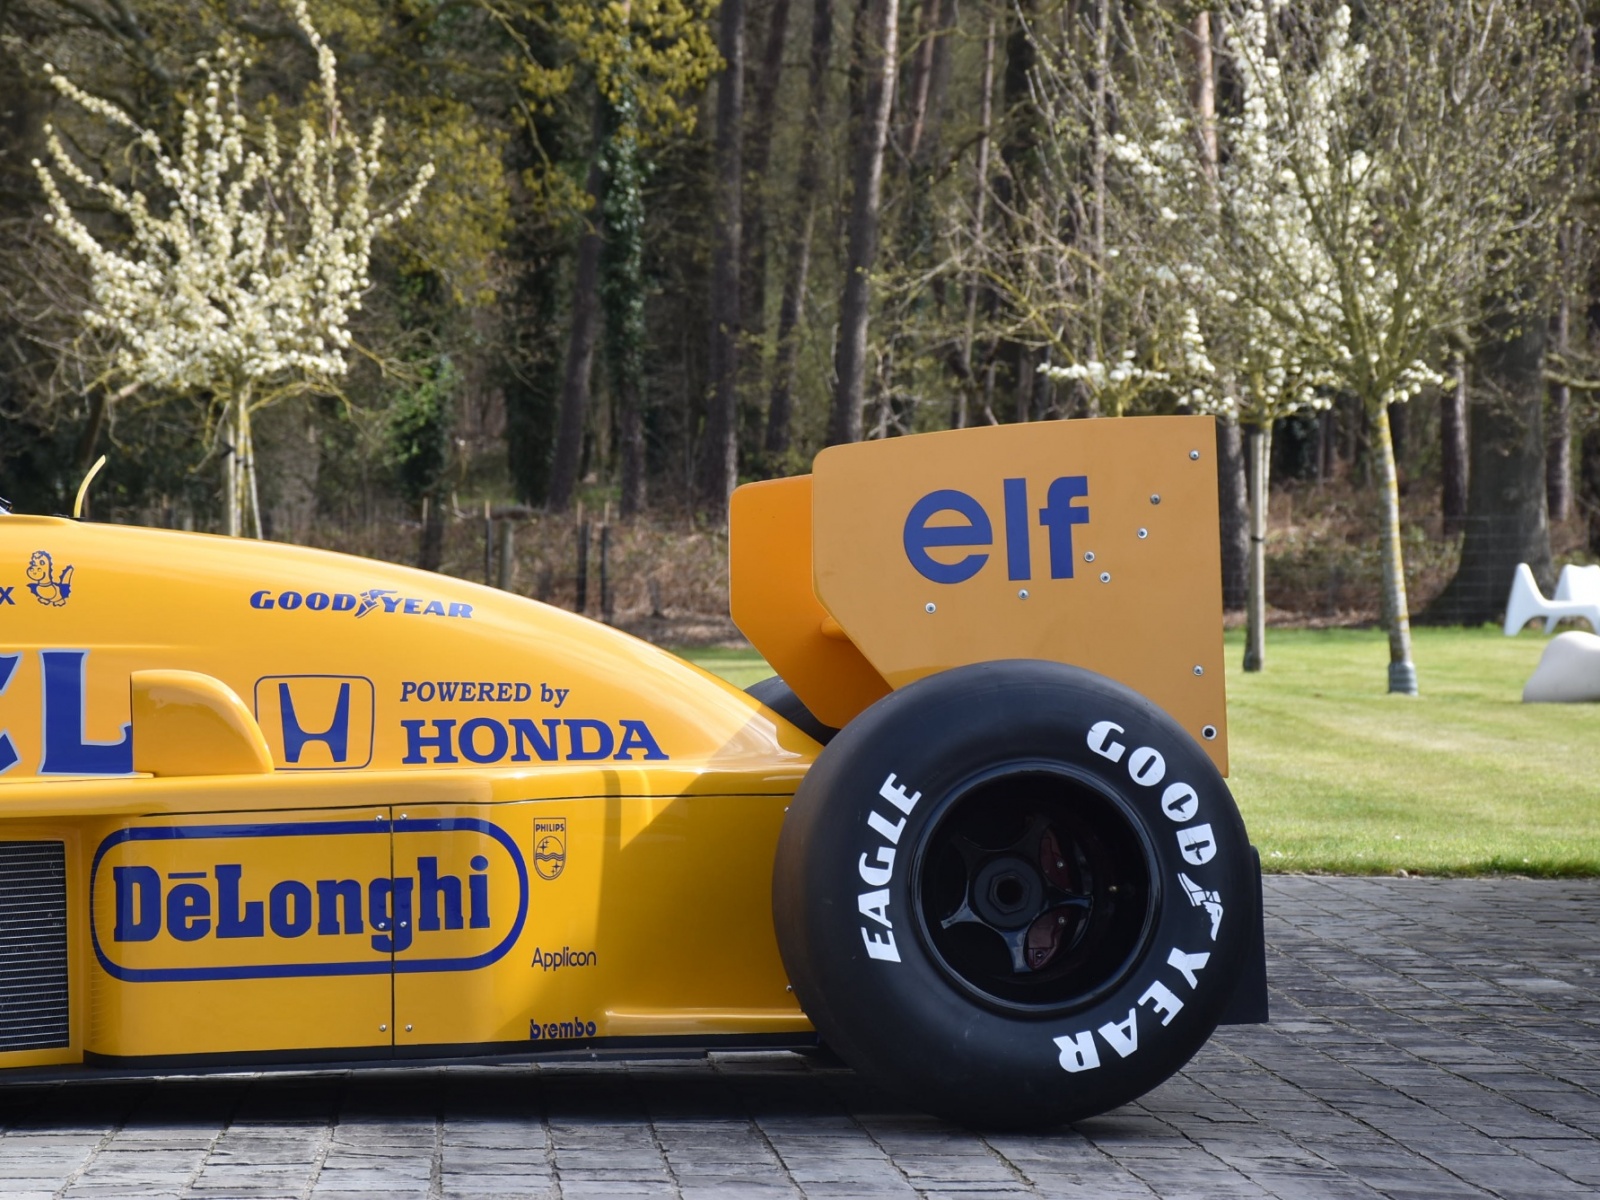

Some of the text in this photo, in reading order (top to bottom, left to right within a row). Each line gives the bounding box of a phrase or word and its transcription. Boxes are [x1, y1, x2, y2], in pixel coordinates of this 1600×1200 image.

[903, 475, 1090, 585] elf
[400, 681, 569, 708] POWERED by
[400, 717, 669, 764] HONDA
[535, 823, 565, 832] PHILIPS
[857, 773, 922, 963] EAGLE
[531, 947, 597, 972] Applicon
[529, 1017, 597, 1039] brembo
